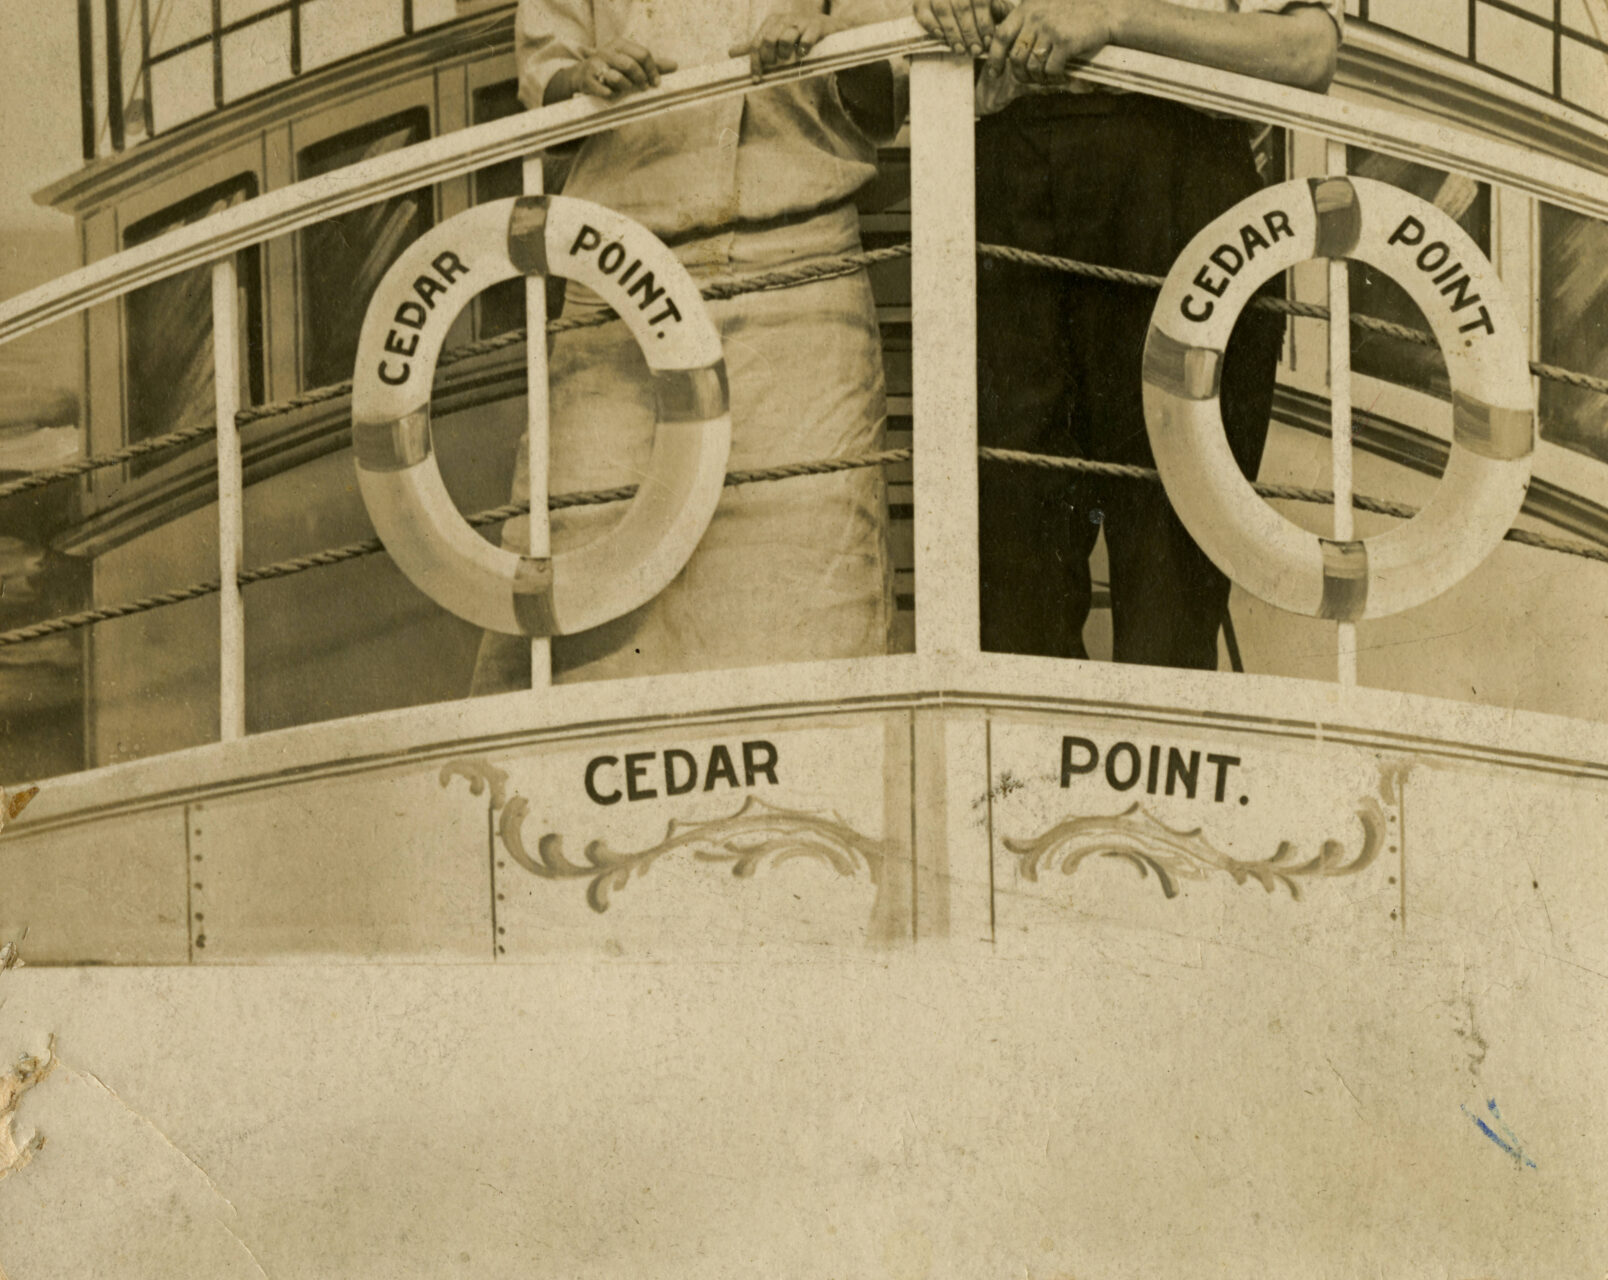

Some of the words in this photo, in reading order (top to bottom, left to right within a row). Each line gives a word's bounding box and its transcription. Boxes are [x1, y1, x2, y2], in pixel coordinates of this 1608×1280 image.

[377, 249, 471, 387] CEDAR
[568, 223, 683, 340] POINT.
[1180, 209, 1296, 323] CEDAR
[1387, 214, 1496, 348] POINT.
[584, 739, 780, 806] CEDAR
[1059, 735, 1250, 807] POINT.
